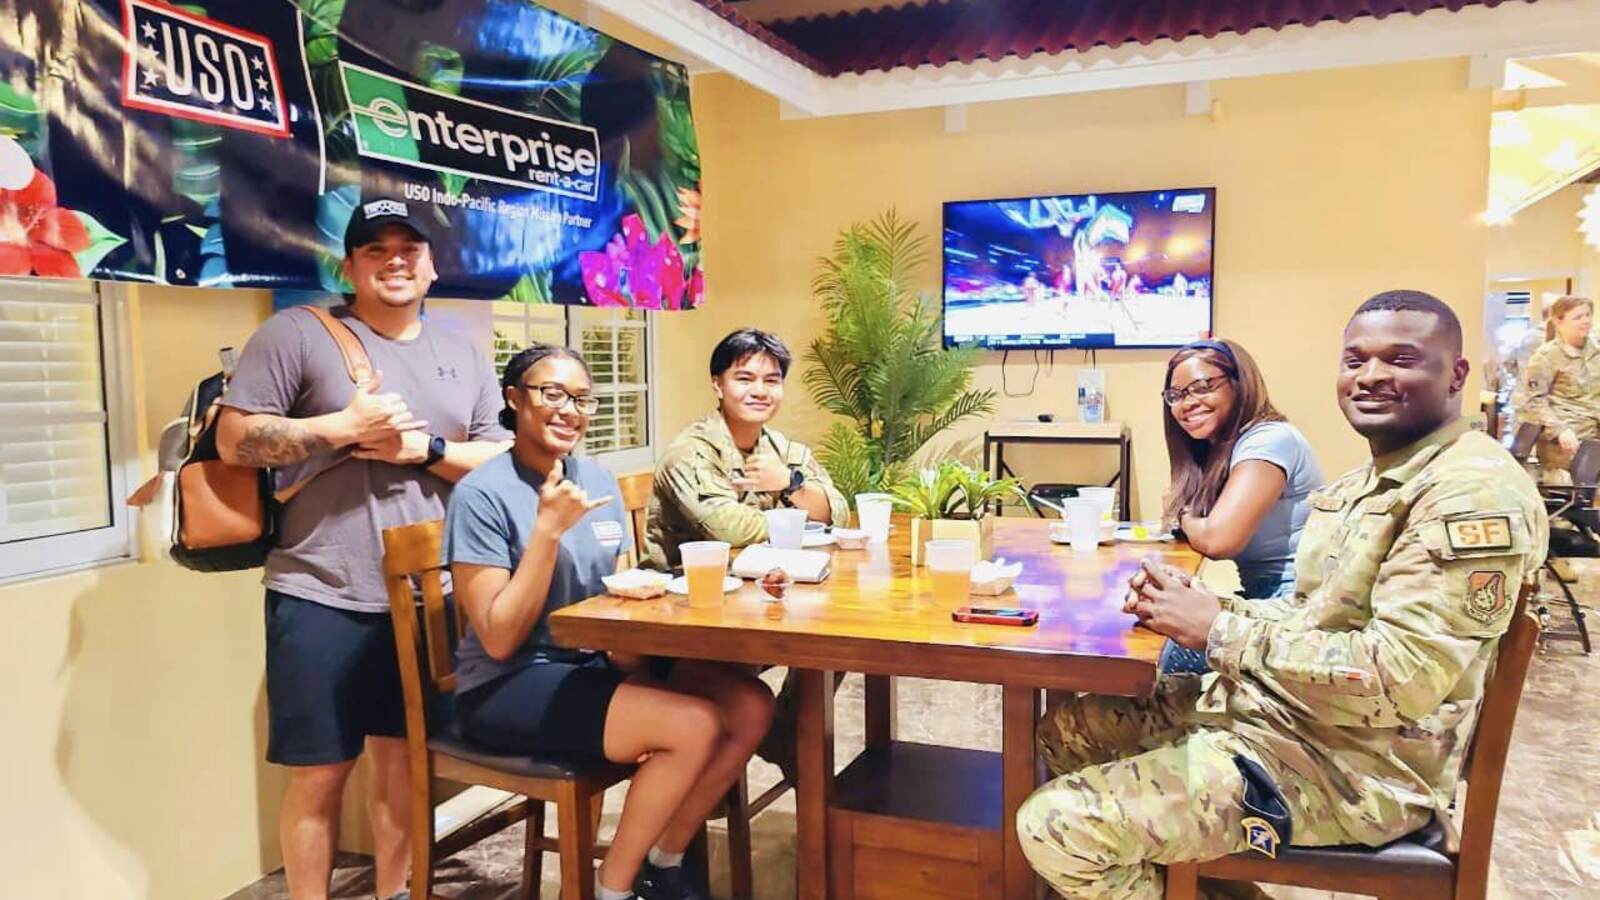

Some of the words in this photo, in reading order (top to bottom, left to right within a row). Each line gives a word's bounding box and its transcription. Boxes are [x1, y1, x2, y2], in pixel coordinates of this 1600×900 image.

[160, 21, 254, 110] USO
[369, 97, 596, 176] enterprise
[528, 168, 594, 192] rent-a-car
[403, 183, 430, 202] USO
[432, 187, 496, 212] Indo-Pacific
[498, 199, 529, 219] Region
[563, 211, 592, 228] Partner
[1457, 521, 1500, 545] SF
